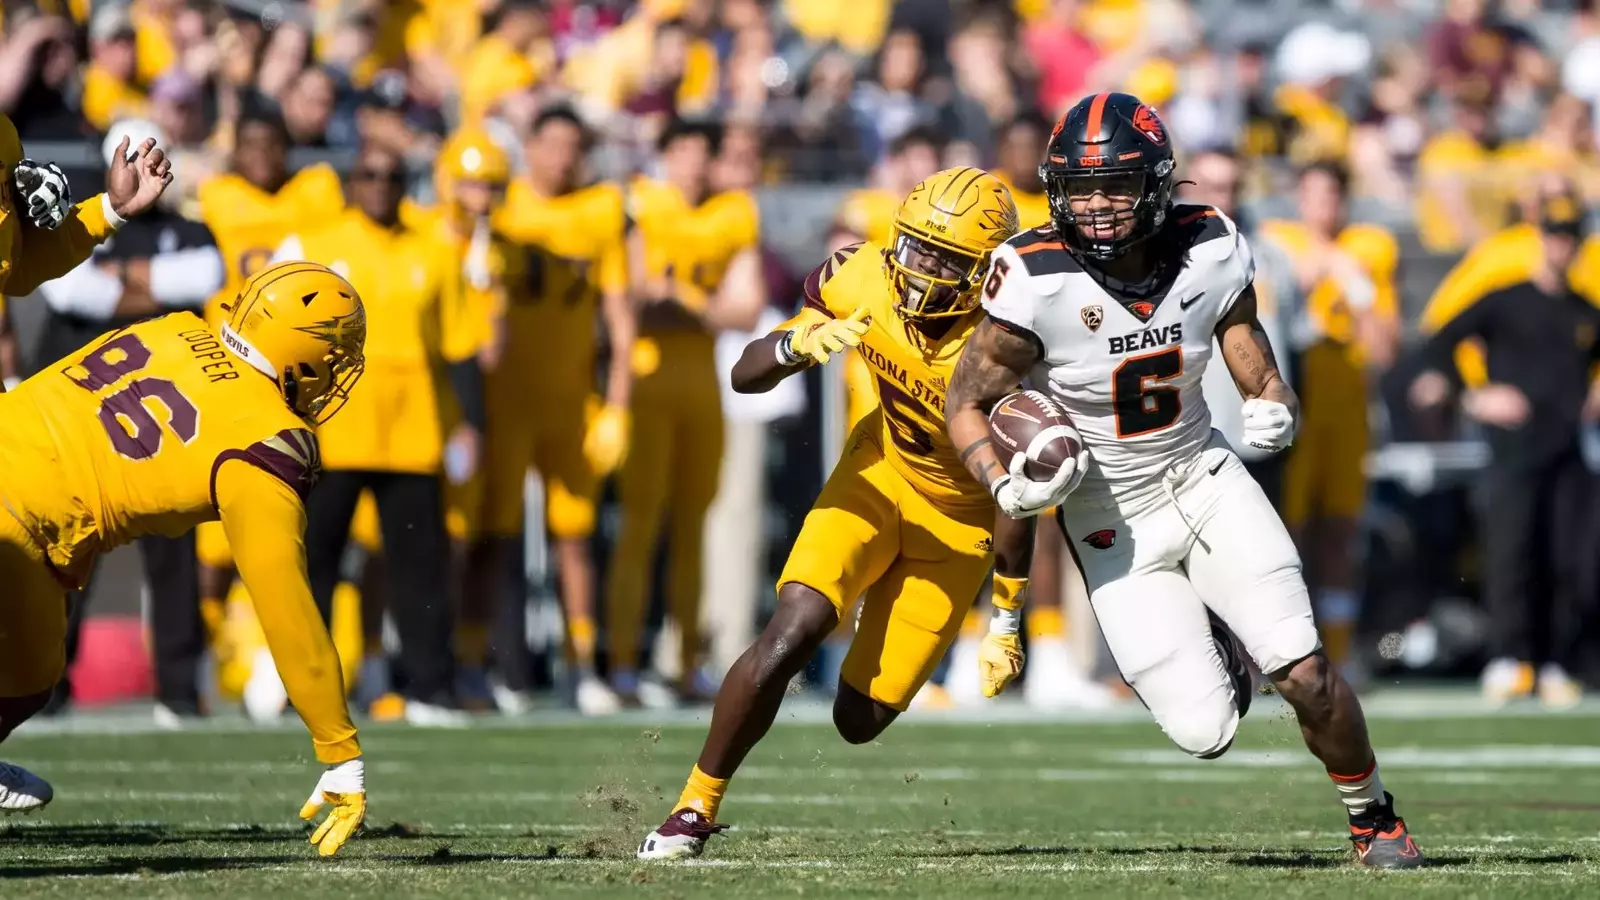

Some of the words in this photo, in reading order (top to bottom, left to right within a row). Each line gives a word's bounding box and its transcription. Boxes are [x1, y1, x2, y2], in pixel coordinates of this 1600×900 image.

[1080, 156, 1104, 167] OSU
[984, 256, 1011, 300] 6
[1081, 306, 1102, 321] PAC
[1087, 316, 1099, 326] 12
[178, 329, 240, 384] COOPER
[1108, 322, 1183, 354] BEAVS
[857, 341, 909, 389] IZONA
[61, 332, 200, 462] 96
[875, 372, 935, 457] 5
[1111, 344, 1184, 440] 6
